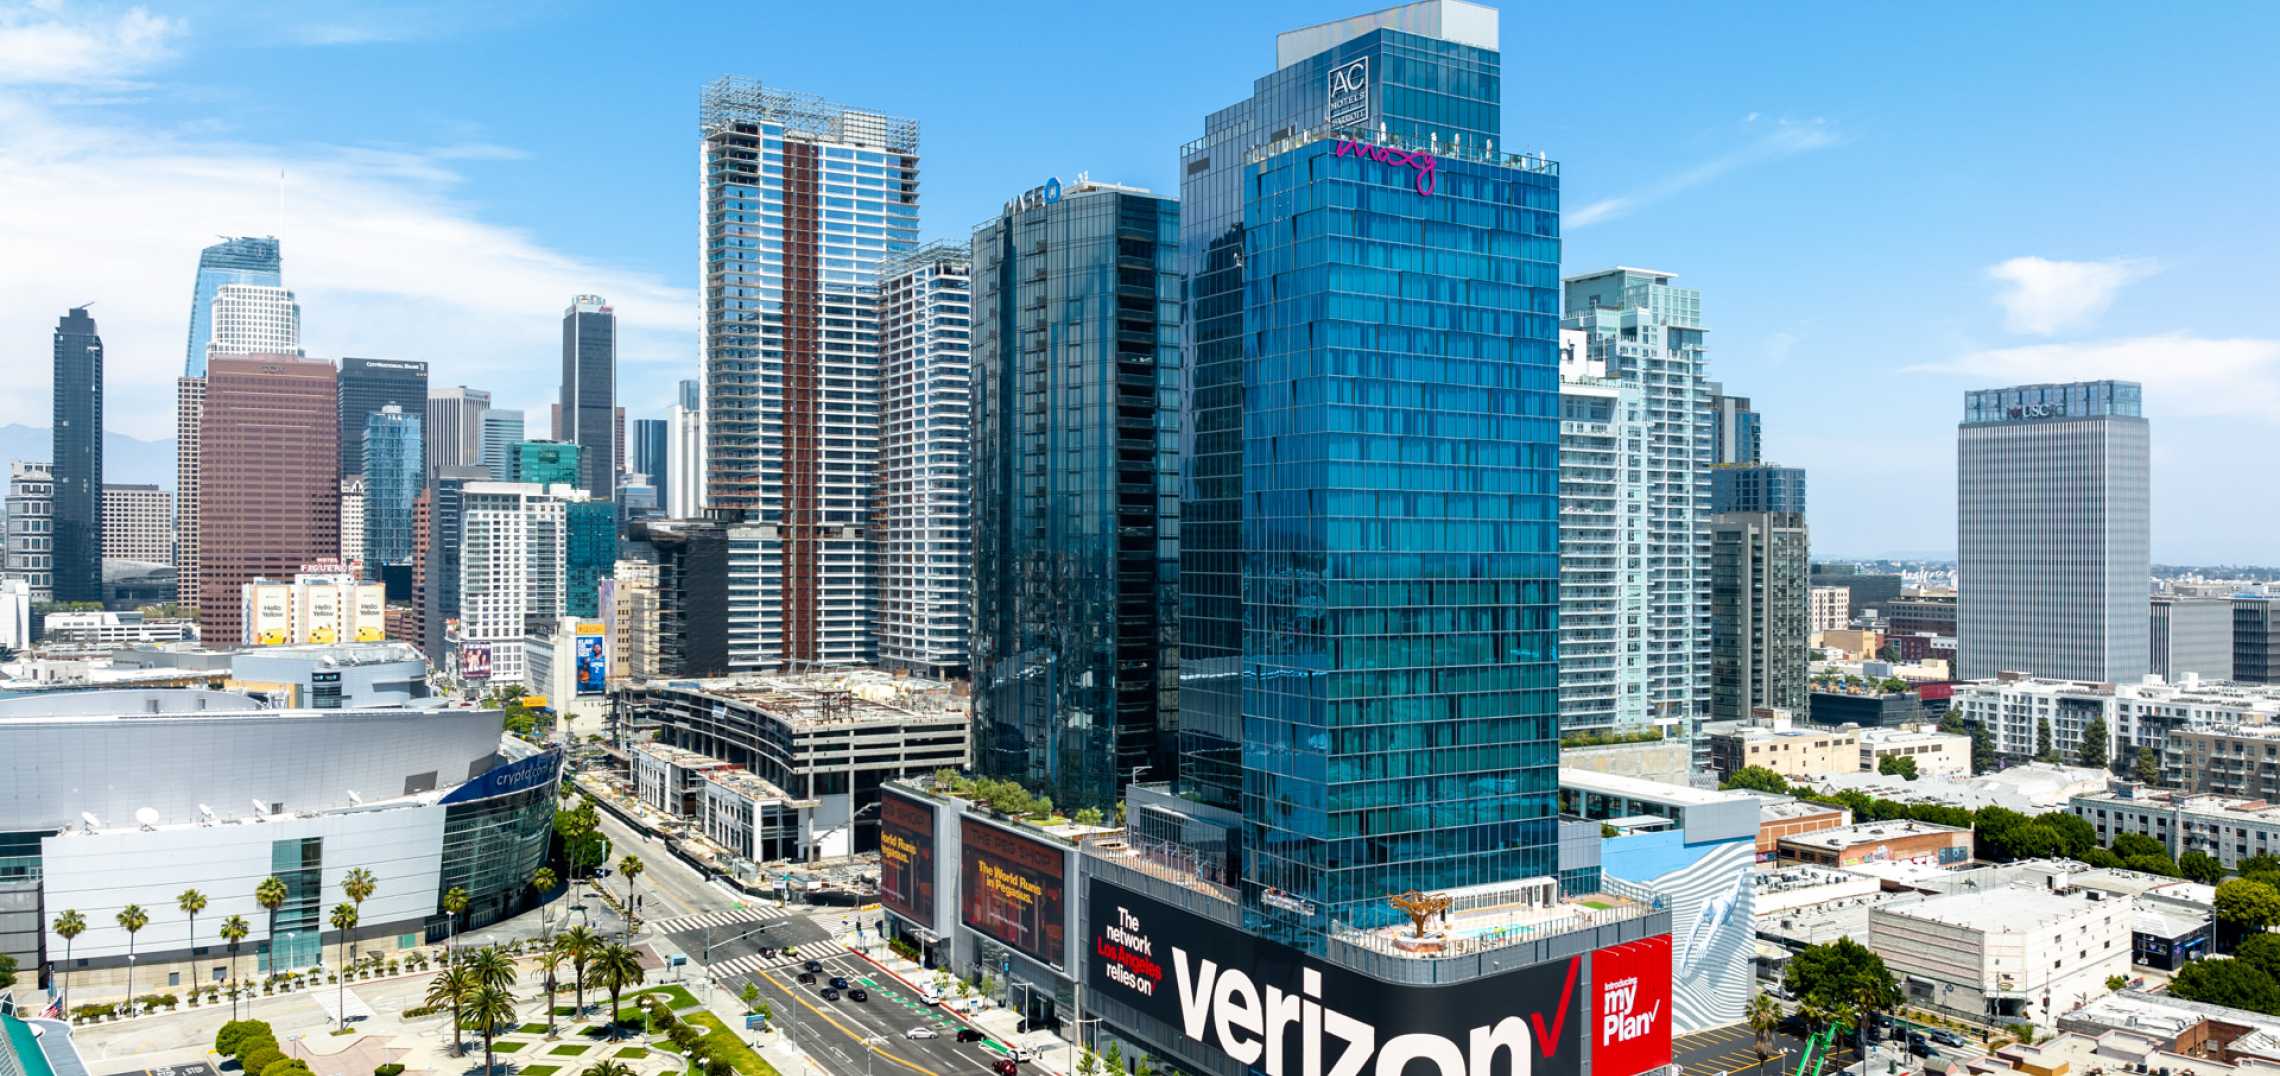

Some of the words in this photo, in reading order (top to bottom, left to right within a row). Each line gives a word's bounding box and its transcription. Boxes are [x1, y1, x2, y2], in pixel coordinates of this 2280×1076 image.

[1331, 63, 1365, 98] AC
[1331, 92, 1365, 111] HOTELS
[1336, 139, 1437, 196] moxy
[2022, 404, 2050, 417] USC
[978, 859, 994, 877] The
[994, 866, 1019, 887] World
[1019, 876, 1042, 896] Runs
[997, 883, 1034, 905] Pegasus.
[1117, 905, 1140, 932] The
[1106, 924, 1152, 957] network
[1097, 935, 1117, 961] Los
[1118, 945, 1163, 981] Angeles
[1106, 962, 1136, 989] relies
[1136, 976, 1152, 997] on
[1604, 984, 1637, 1016] my
[1603, 1012, 1650, 1046] Plan
